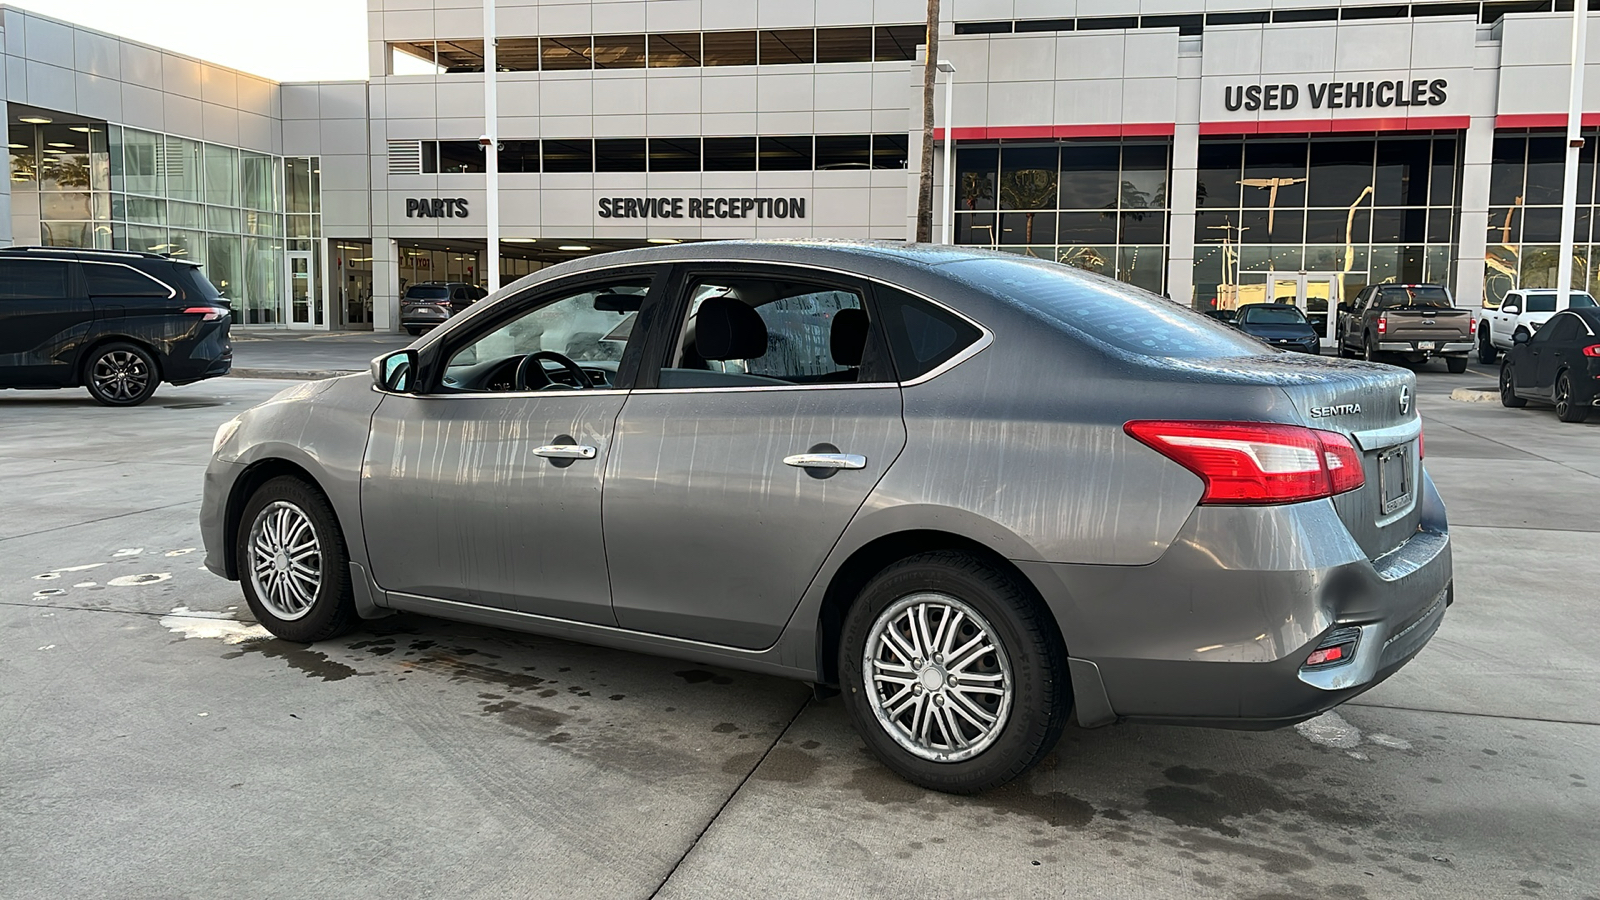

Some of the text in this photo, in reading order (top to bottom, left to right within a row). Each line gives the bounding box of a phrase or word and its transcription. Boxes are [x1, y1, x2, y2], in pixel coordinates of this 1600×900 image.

[1225, 78, 1448, 111] USED VEHICLES
[406, 198, 469, 218] PARTS
[598, 197, 806, 218] SERVICE RECEPTION
[1310, 403, 1361, 418] SENTRA
